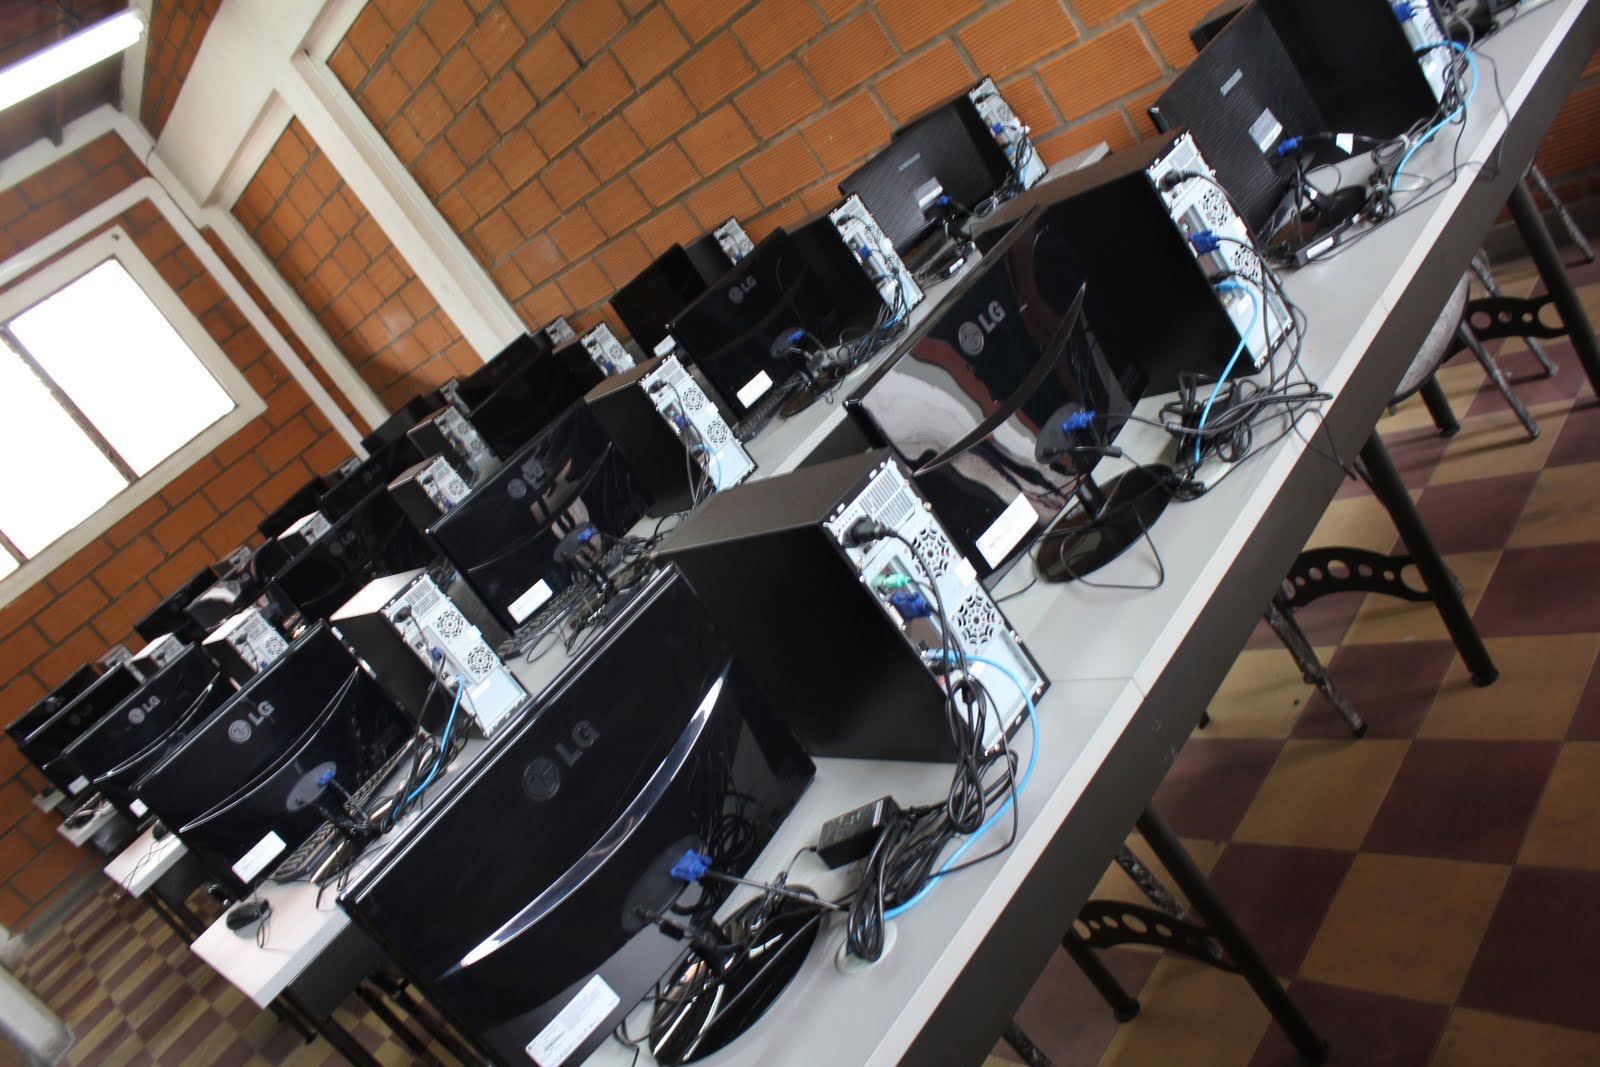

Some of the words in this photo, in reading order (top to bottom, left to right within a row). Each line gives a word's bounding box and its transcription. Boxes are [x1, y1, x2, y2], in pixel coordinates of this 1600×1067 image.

[740, 275, 757, 293] LG
[978, 301, 1006, 334] LG
[523, 462, 544, 482] LG
[142, 695, 160, 712] LG
[248, 701, 274, 725] LG
[555, 719, 600, 766] LG
